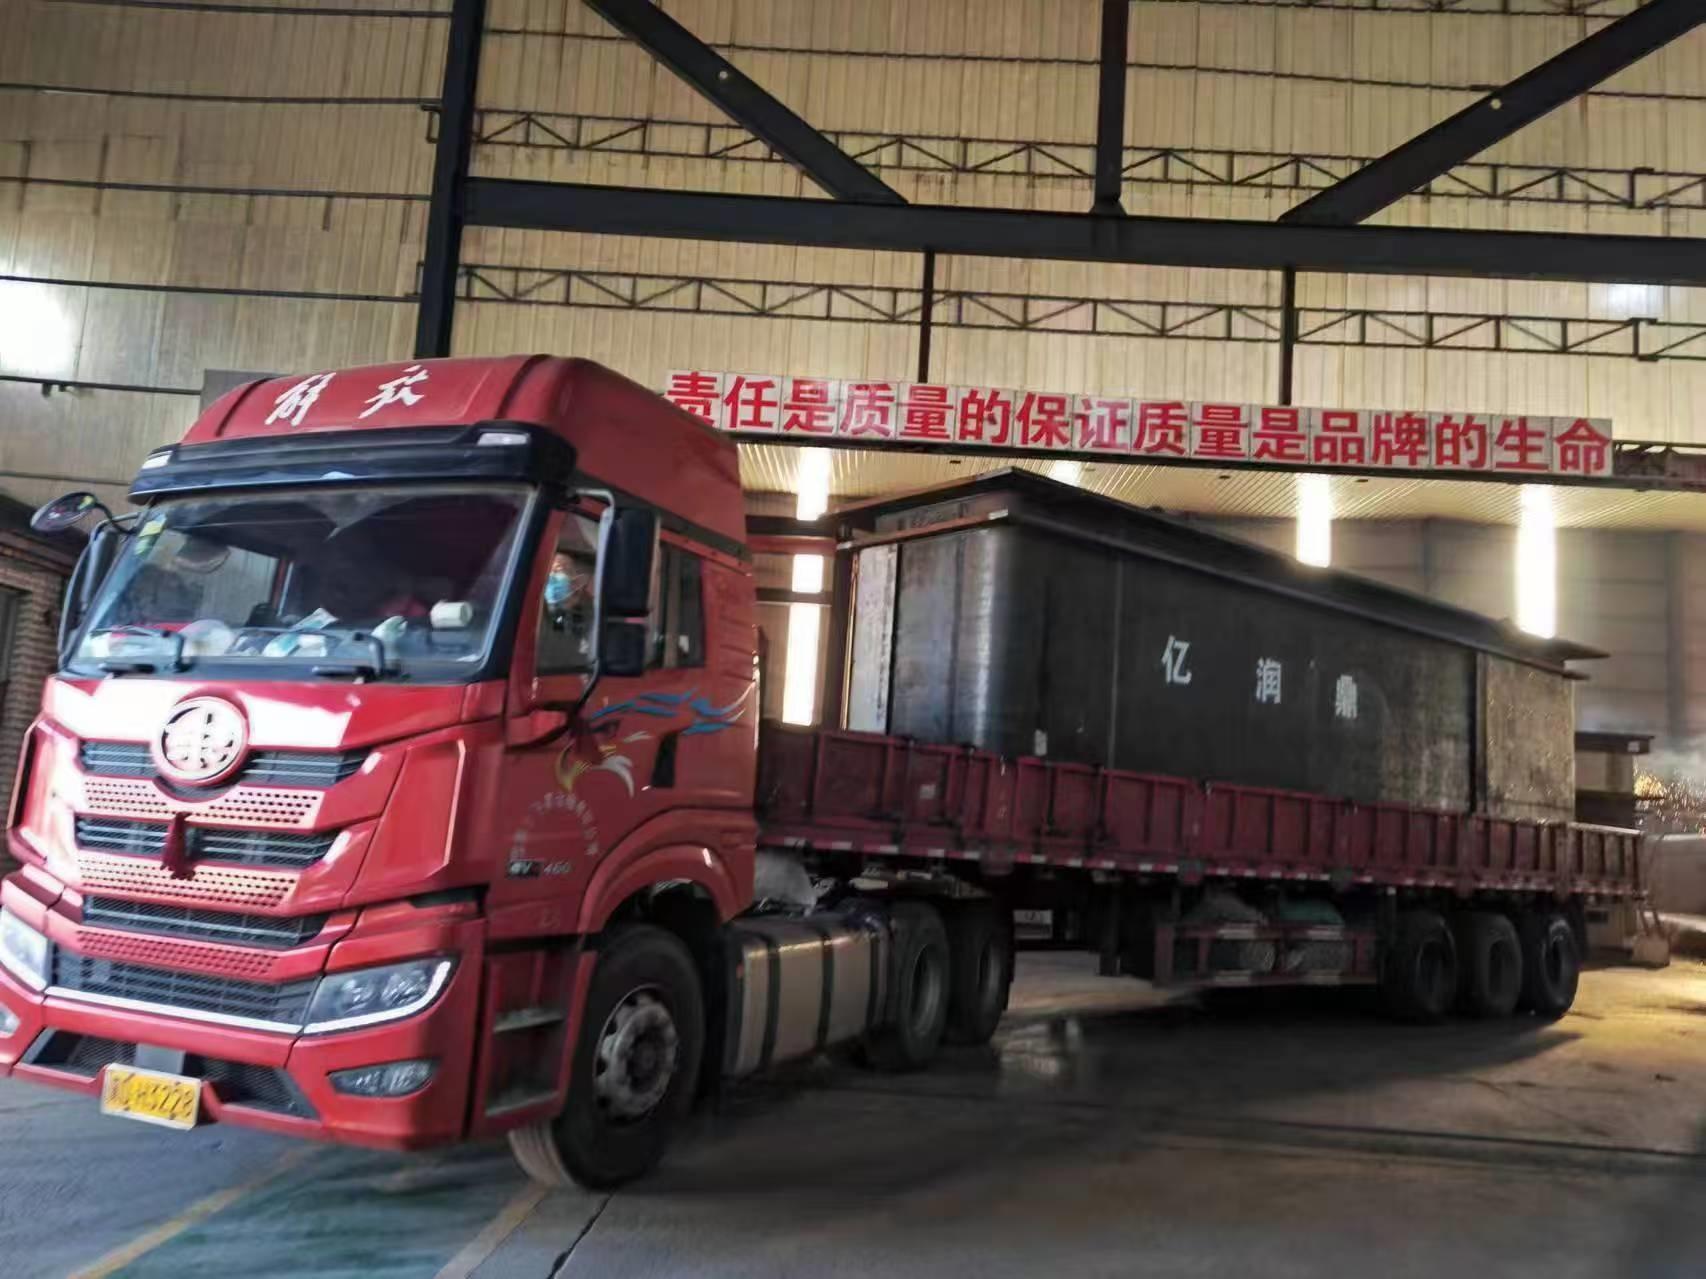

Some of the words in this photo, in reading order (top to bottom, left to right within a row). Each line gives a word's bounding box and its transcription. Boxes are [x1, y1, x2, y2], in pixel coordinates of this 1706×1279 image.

[666, 371, 1612, 475] 责任是质量的保证质量是品牌的生命
